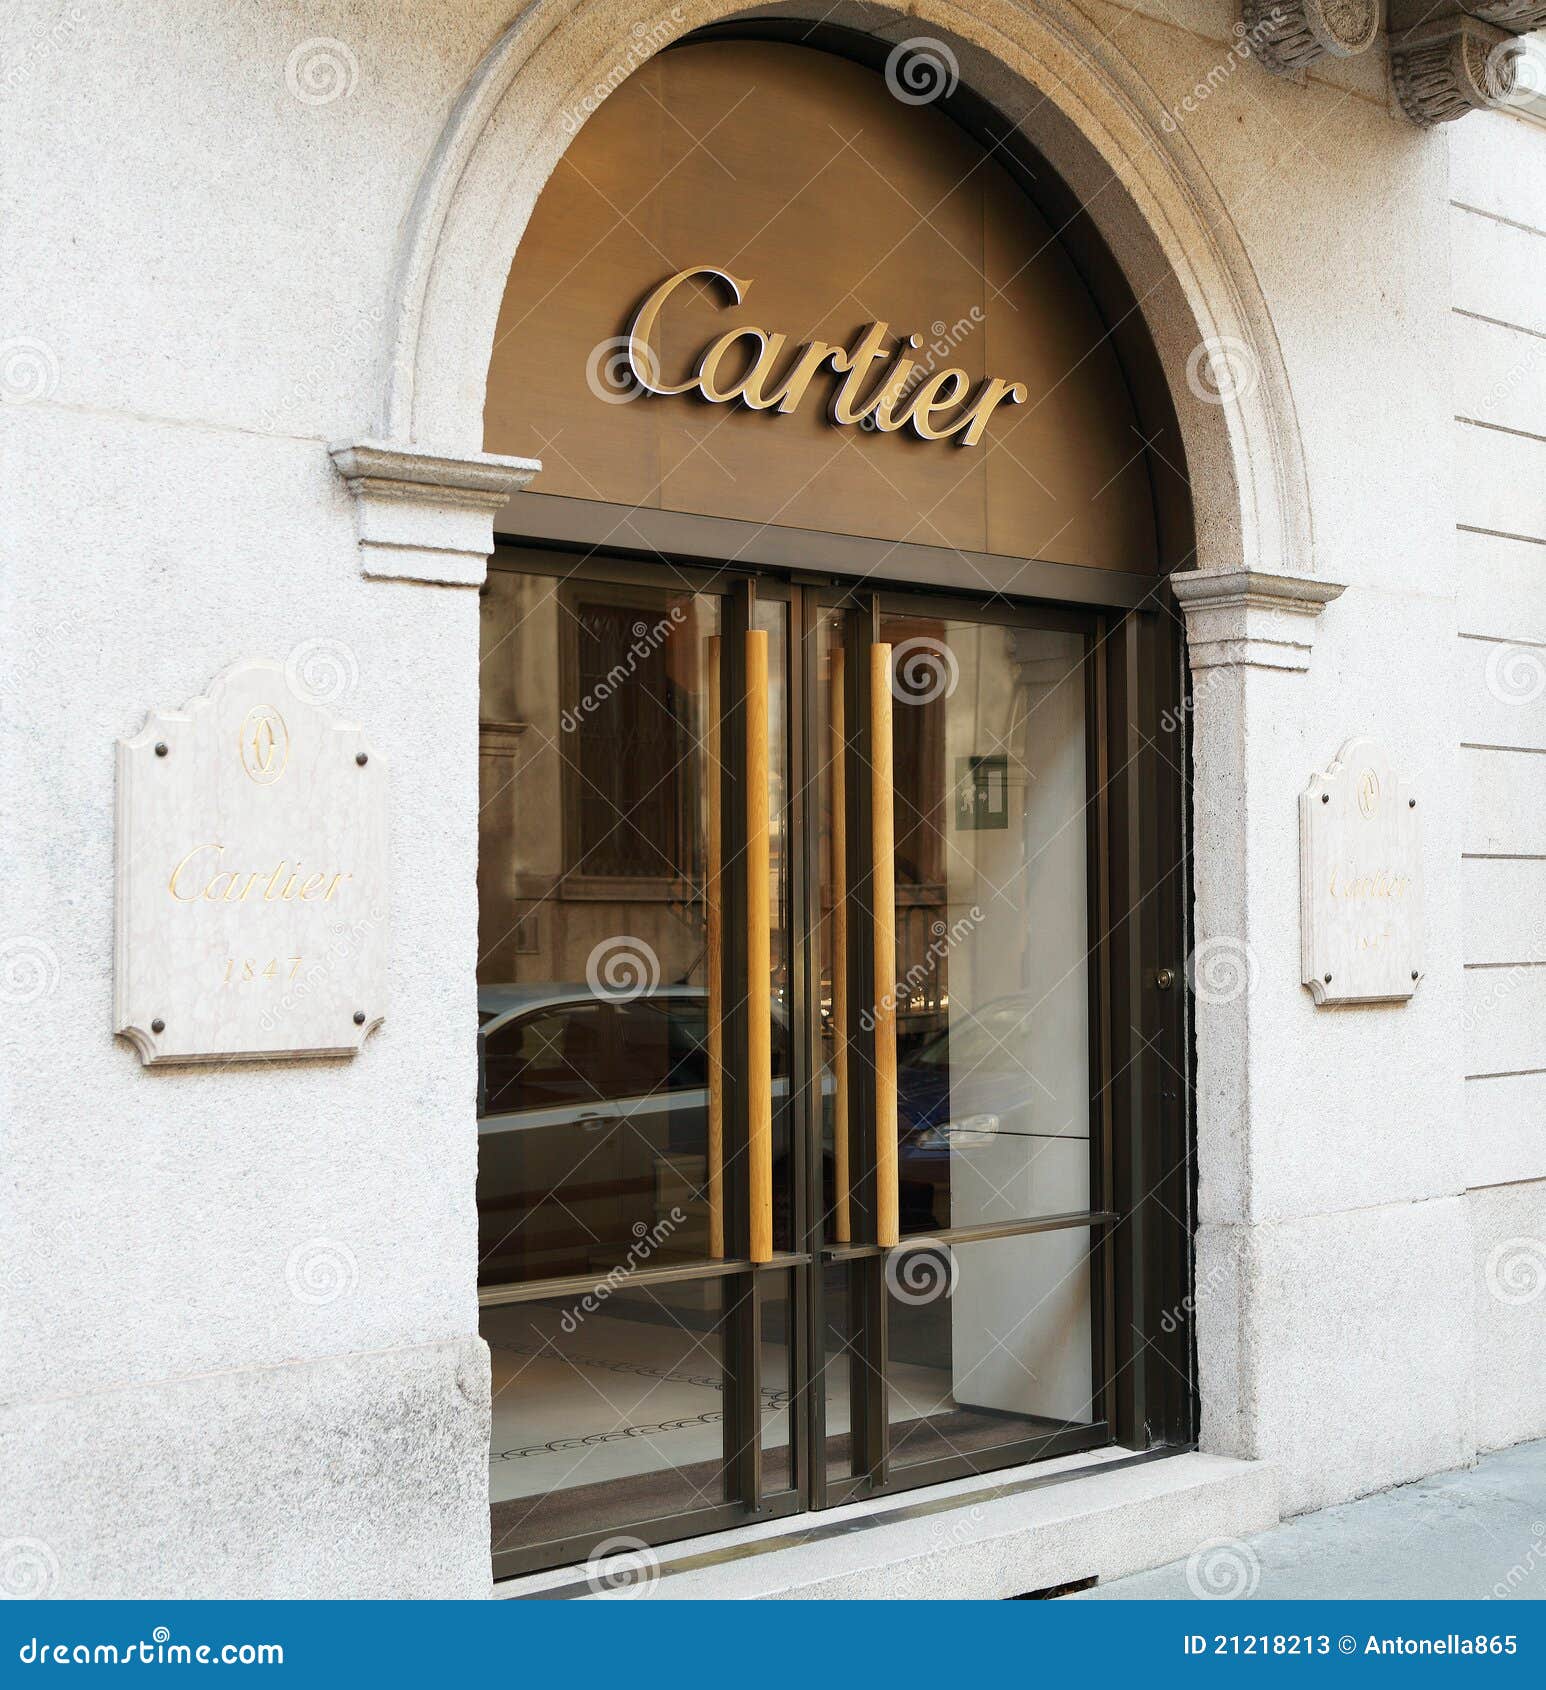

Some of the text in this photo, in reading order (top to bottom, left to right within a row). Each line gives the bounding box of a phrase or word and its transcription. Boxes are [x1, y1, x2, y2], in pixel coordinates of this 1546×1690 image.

[628, 264, 1029, 447] Cartier
[168, 842, 353, 902] Cartier
[223, 955, 303, 984] 1847
